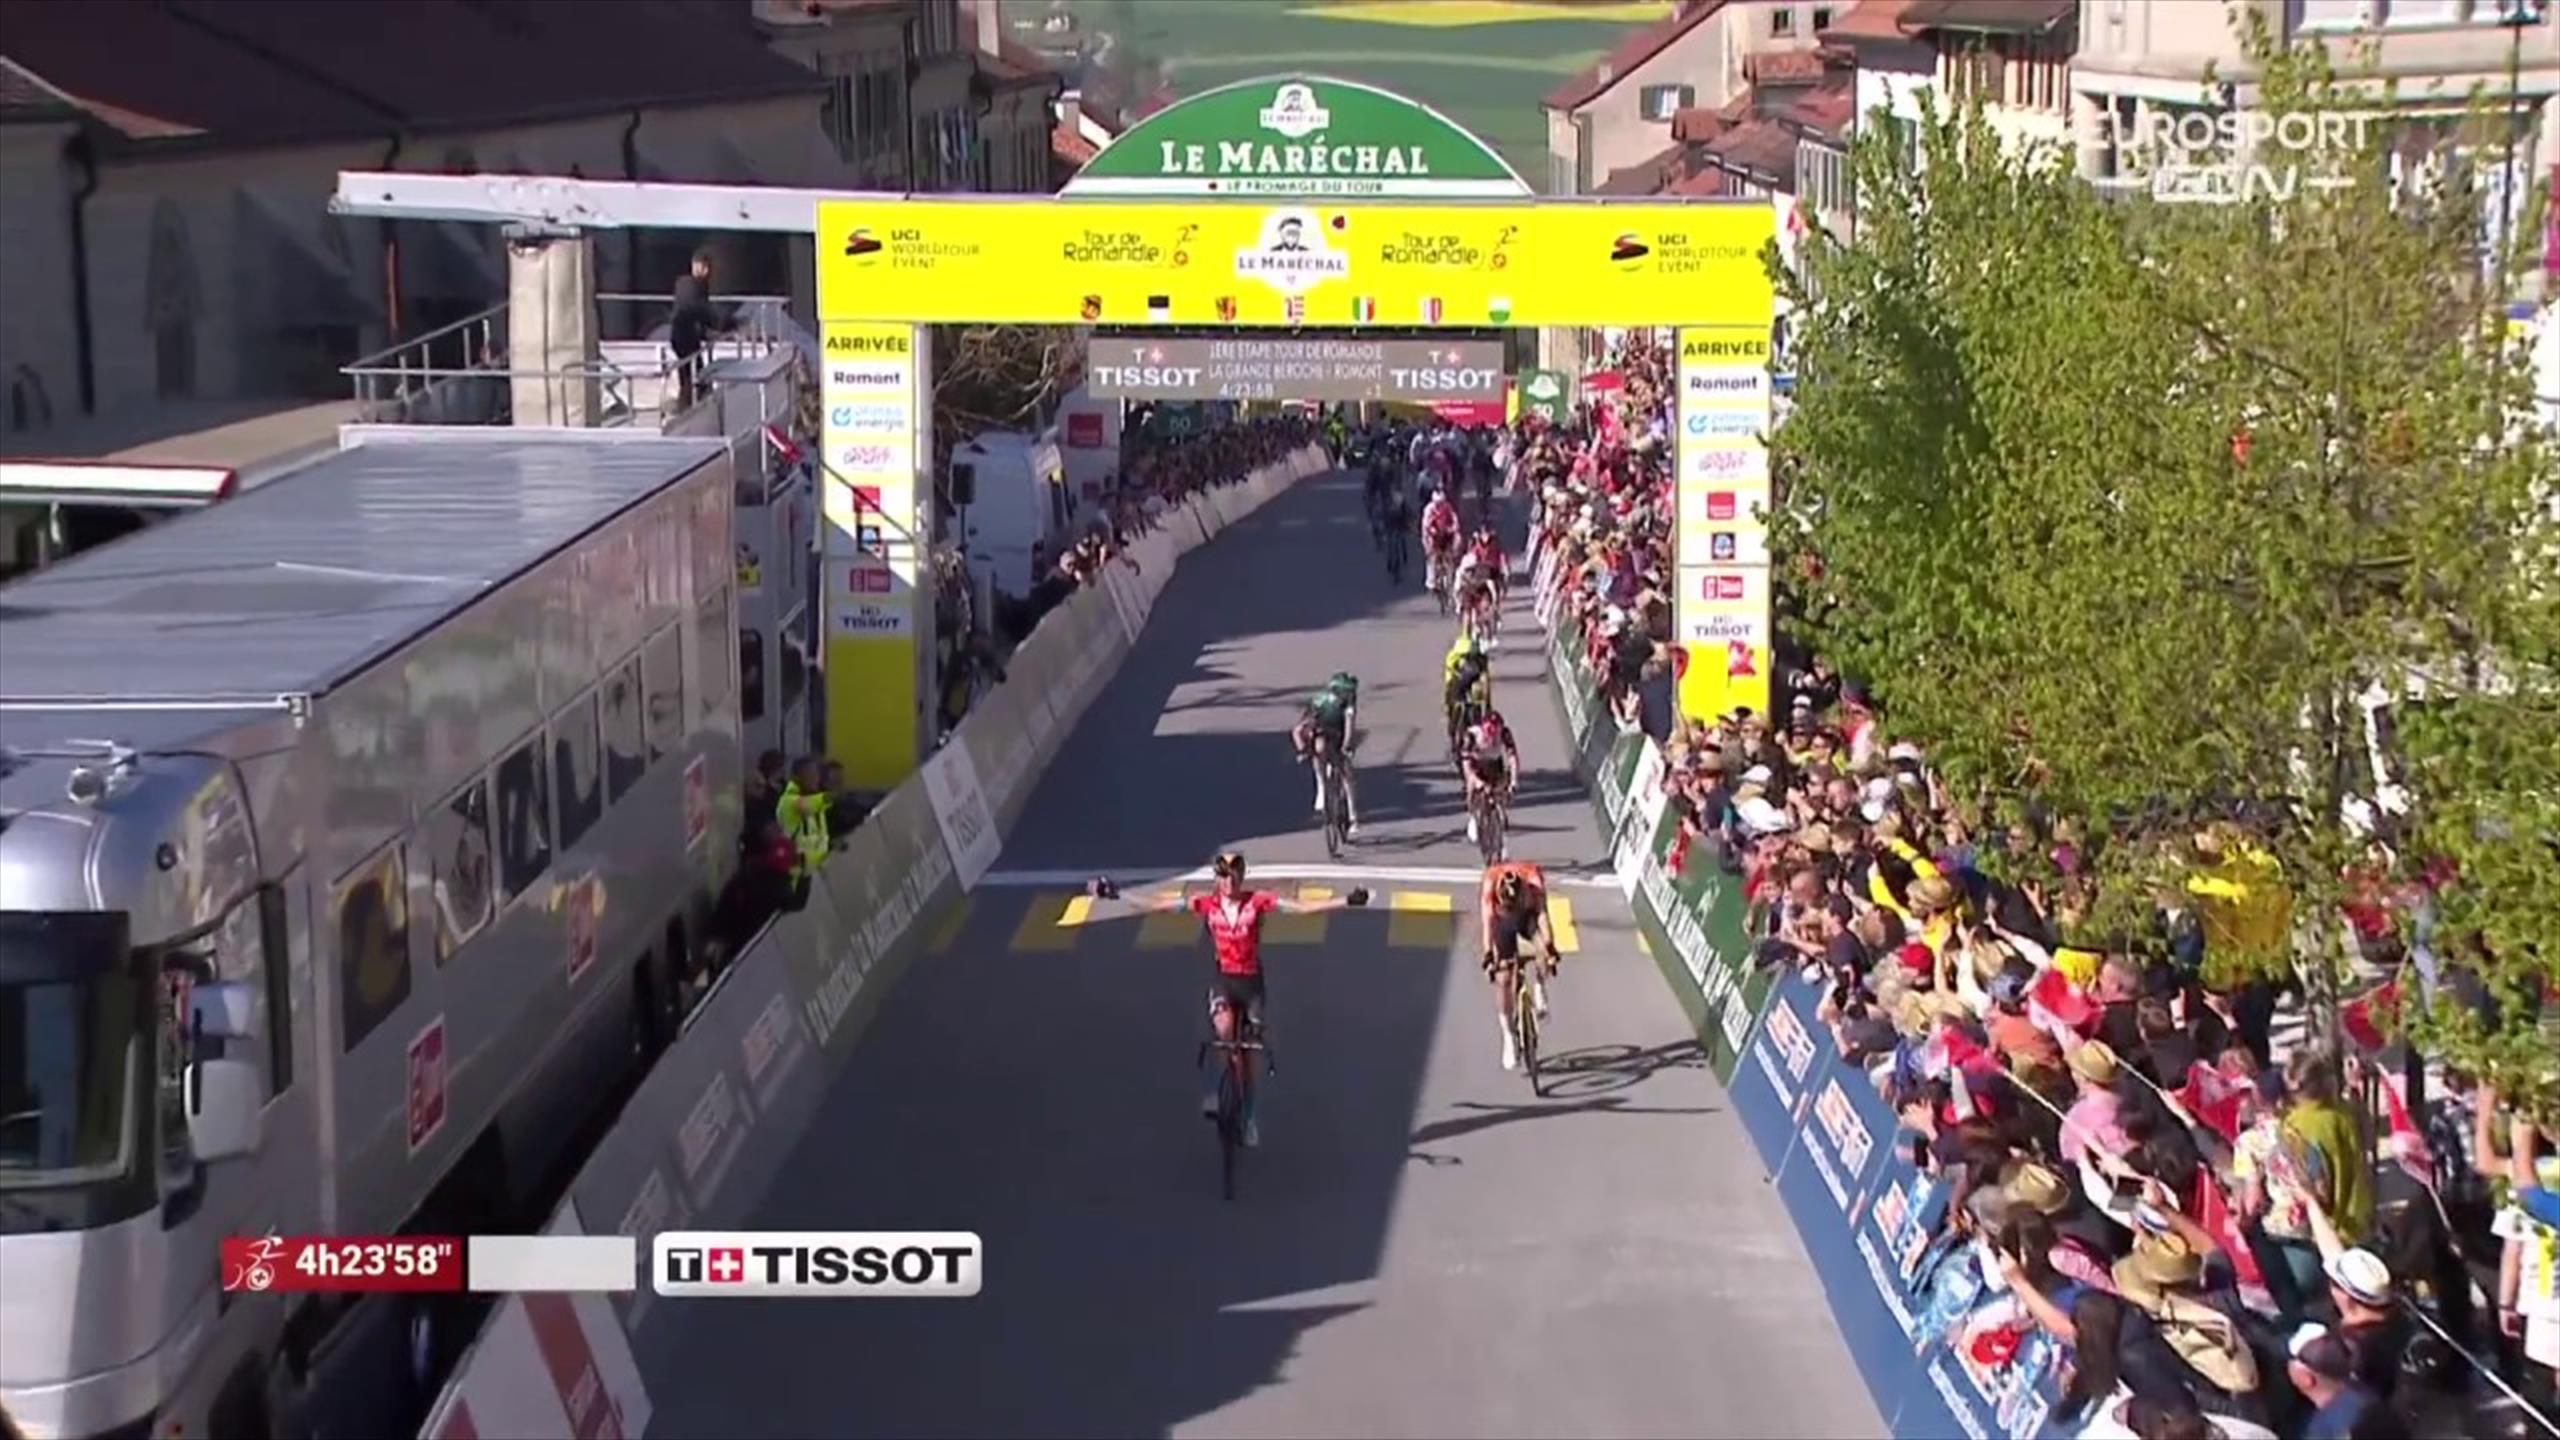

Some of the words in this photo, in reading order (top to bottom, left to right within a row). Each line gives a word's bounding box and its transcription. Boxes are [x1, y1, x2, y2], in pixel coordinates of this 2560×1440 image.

[1160, 140, 1205, 174] LE
[1219, 133, 1429, 174] MARÉCHAL
[1227, 181, 1241, 193] LE
[1246, 181, 1317, 193] FROMAGE
[1322, 181, 1342, 193] DU
[1347, 181, 1383, 193] TOUR
[891, 229, 921, 241] UCI
[1083, 229, 1116, 246] Tour
[1119, 231, 1141, 246] de
[1402, 231, 1434, 248] Tour
[1438, 235, 1460, 249] de
[1657, 233, 1687, 245] UCI
[891, 241, 980, 256] WORLDTOUR
[1063, 241, 1160, 262] Romandie
[1381, 244, 1479, 264] Romandie
[1658, 246, 1747, 259] WORLDTOUR
[891, 256, 936, 269] EVENT
[1238, 256, 1255, 270] LE
[1658, 260, 1701, 273] EVENT
[826, 335, 909, 352] ARRIVÉE
[1274, 341, 1304, 359] TOUR
[1306, 341, 1321, 359] DE
[1323, 341, 1382, 360] ROMANDIE
[1684, 340, 1767, 356] ARRIVÉE
[833, 370, 901, 384] Romont
[1094, 366, 1203, 387] TISSOT
[1208, 362, 1223, 379] LA
[1225, 362, 1271, 379] GRANDE
[1334, 362, 1382, 380] ROMONT
[1389, 368, 1498, 389] TISSOT
[1691, 375, 1758, 389] Romont
[840, 616, 899, 630] TISSOT
[1694, 624, 1752, 637] TISSOT
